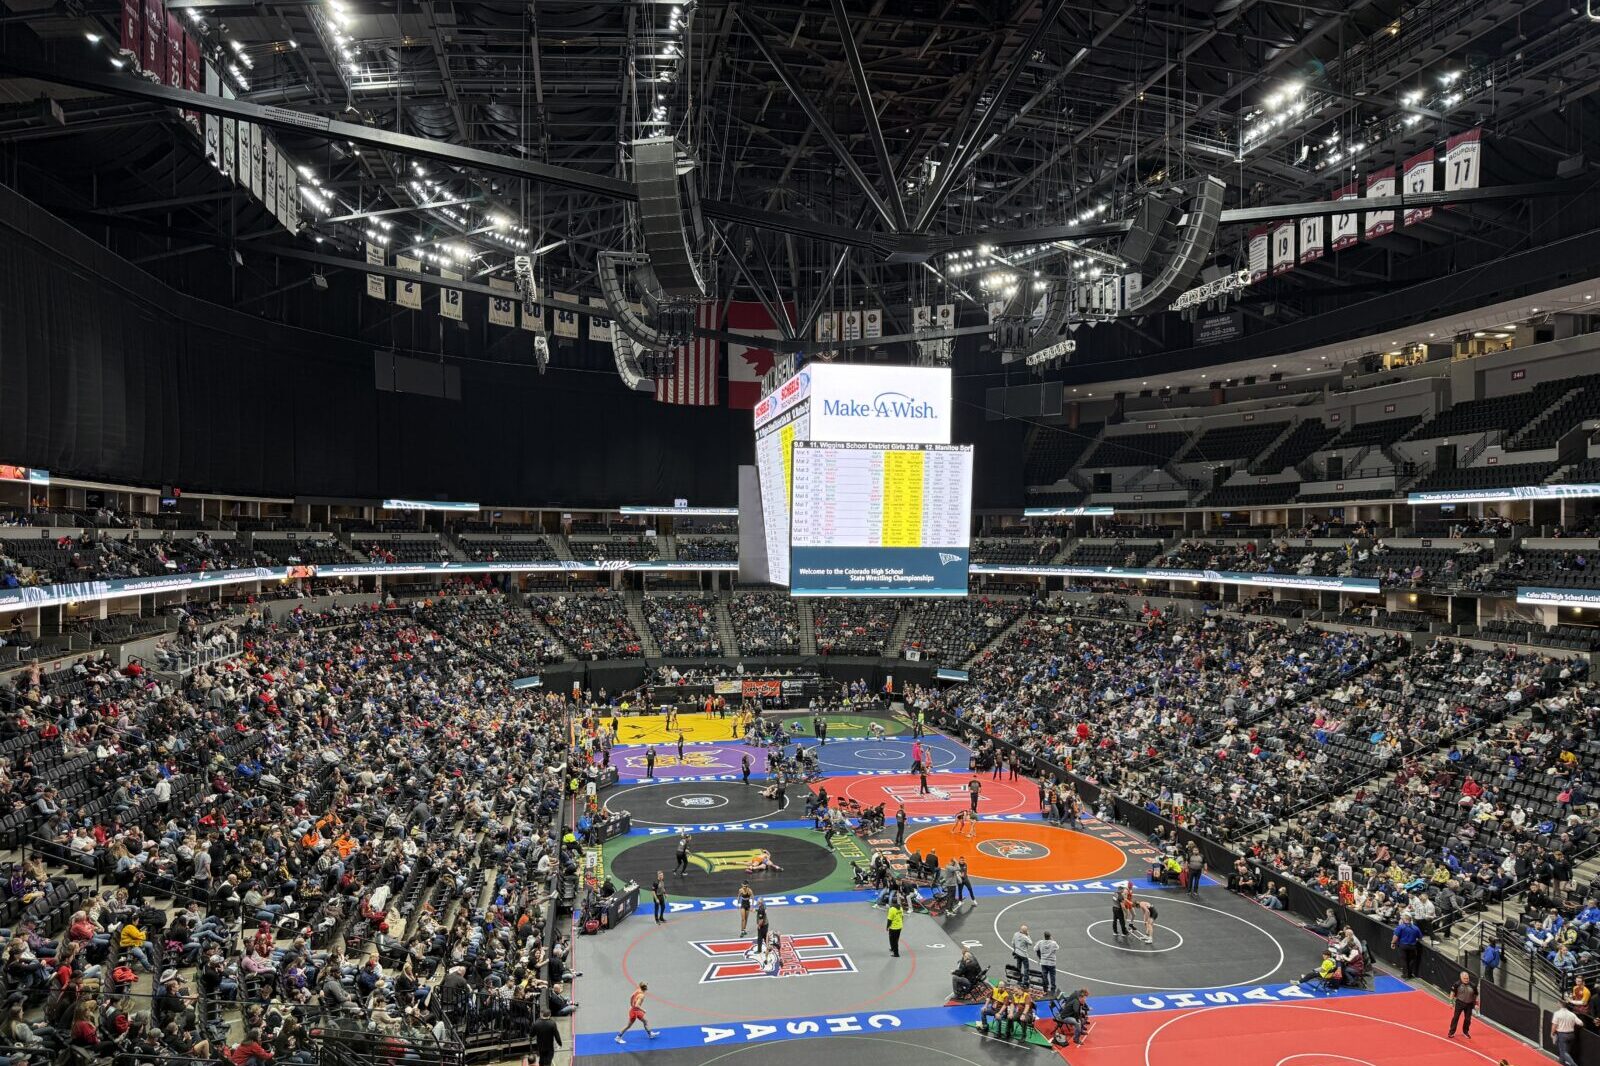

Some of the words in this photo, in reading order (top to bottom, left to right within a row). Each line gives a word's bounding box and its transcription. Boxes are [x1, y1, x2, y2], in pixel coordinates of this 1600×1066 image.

[1410, 168, 1426, 178] FOOTE
[1454, 157, 1471, 185] 77
[1307, 222, 1316, 244] 21
[1278, 238, 1288, 257] 19
[446, 288, 459, 306] 12
[558, 311, 574, 324] 44
[820, 442, 844, 450] Wiggins
[871, 568, 884, 576] High
[1564, 593, 1583, 601] School
[912, 813, 1026, 823] CHAA
[648, 823, 768, 835] CHSAA
[1341, 872, 1349, 880] 10
[996, 880, 1136, 894] CHSAA
[1132, 985, 1315, 1010] CHSAA
[700, 1014, 902, 1044] CHSAA
